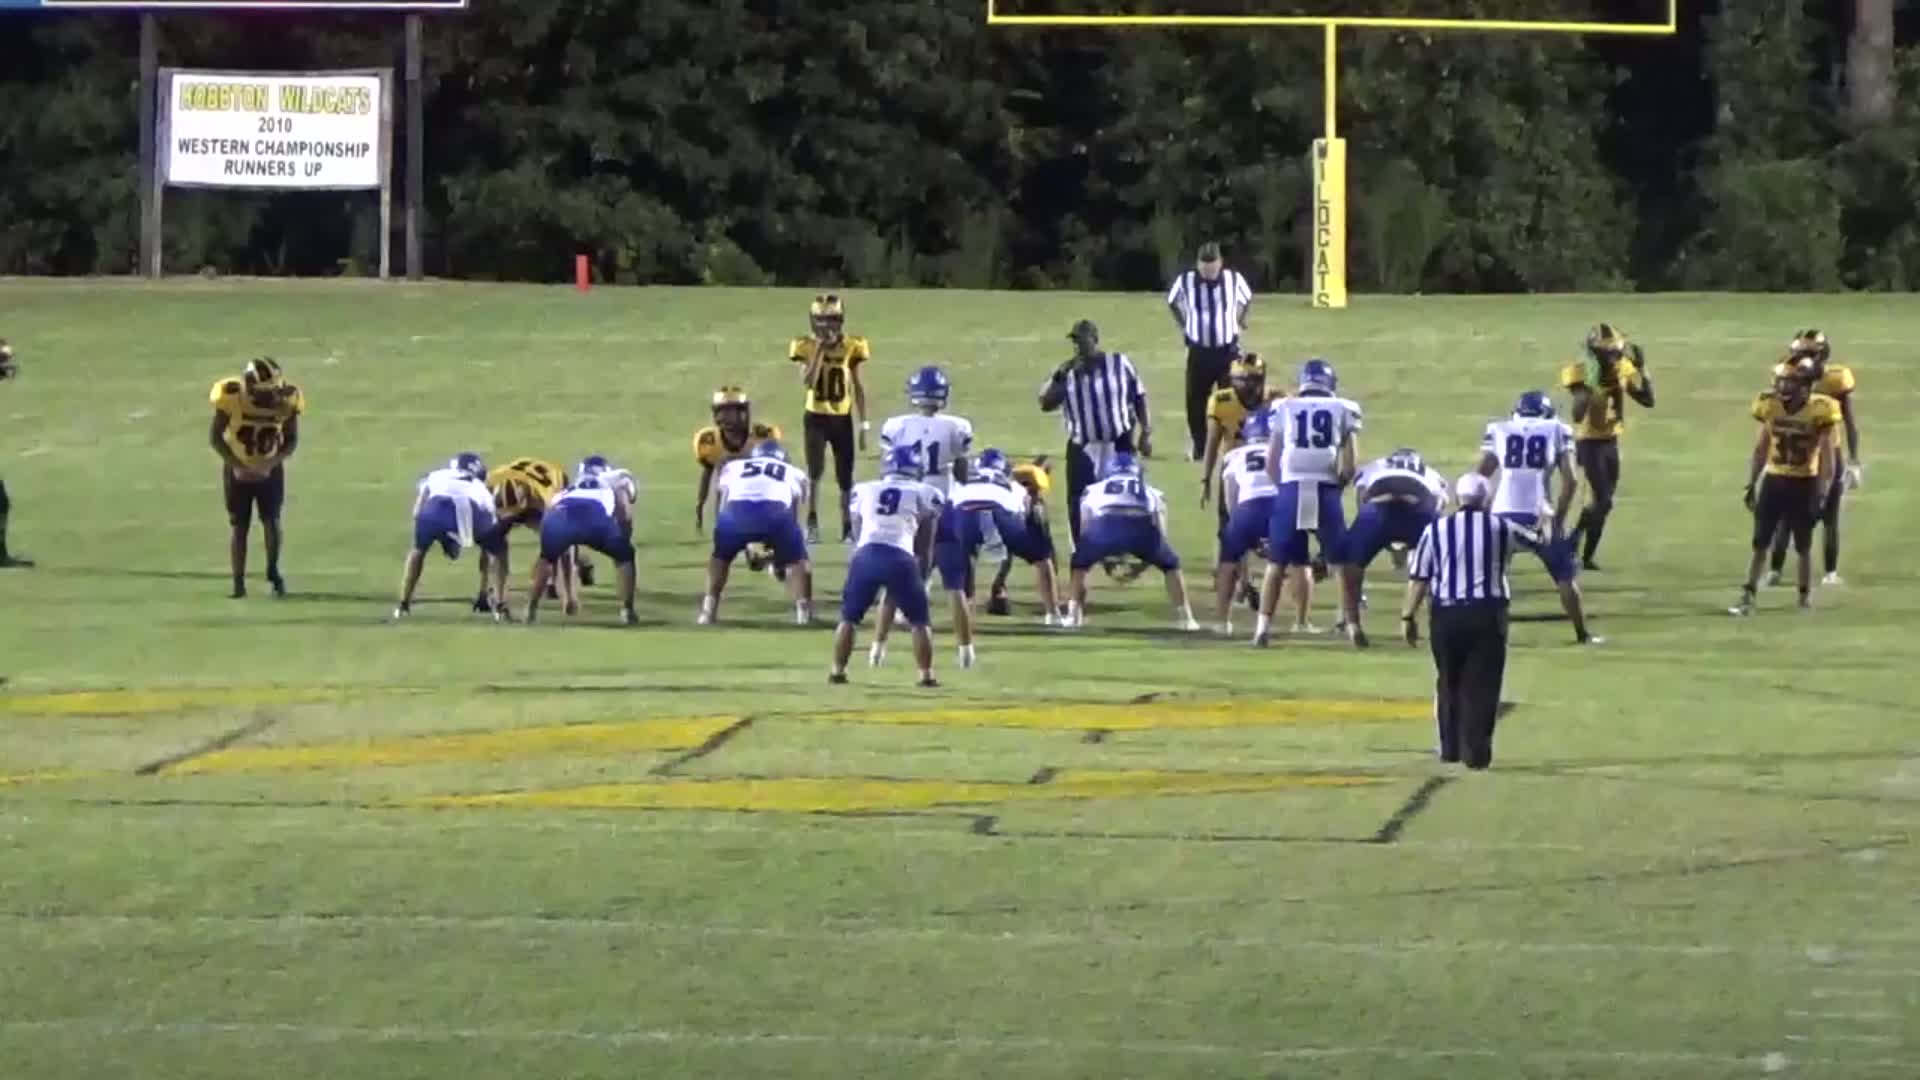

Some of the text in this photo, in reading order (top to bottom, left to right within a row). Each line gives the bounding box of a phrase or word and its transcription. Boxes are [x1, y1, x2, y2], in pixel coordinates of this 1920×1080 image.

[279, 84, 371, 114] WILDCATS
[258, 117, 292, 133] 2010
[178, 138, 370, 158] WESTERN CHAMPIONSHIP
[224, 159, 323, 177] RUNNERS UP
[1317, 141, 1330, 307] WILDCATS
[1295, 409, 1333, 448] 19
[1504, 434, 1548, 469] 88
[740, 461, 787, 482] 50
[875, 487, 902, 516] 9
